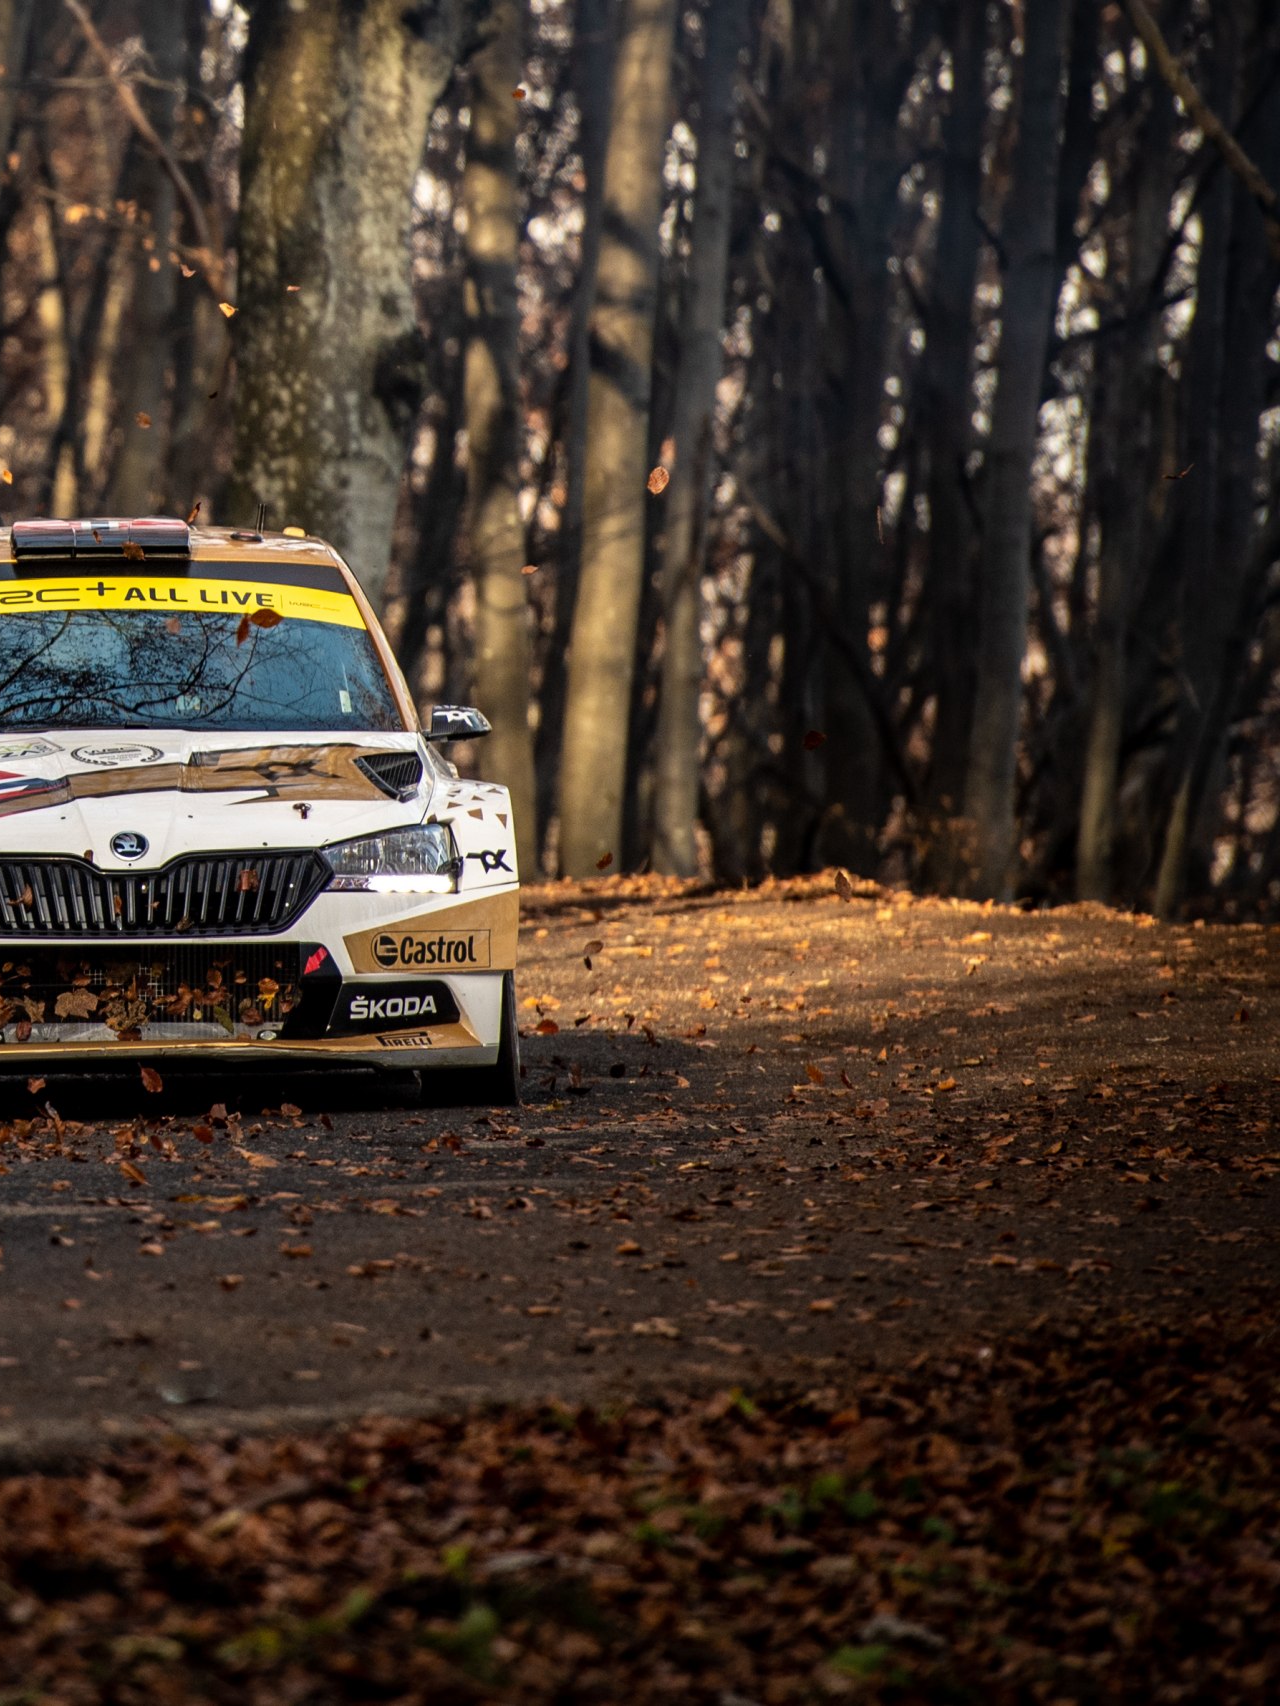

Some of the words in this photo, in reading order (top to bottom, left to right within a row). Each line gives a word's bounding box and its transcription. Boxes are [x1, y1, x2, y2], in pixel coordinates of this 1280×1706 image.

[124, 587, 188, 603] ALL
[200, 589, 275, 608] LIVE
[400, 935, 477, 965] Castrol
[349, 995, 437, 1020] ŠKODA
[376, 1032, 433, 1047] PIRELLI
